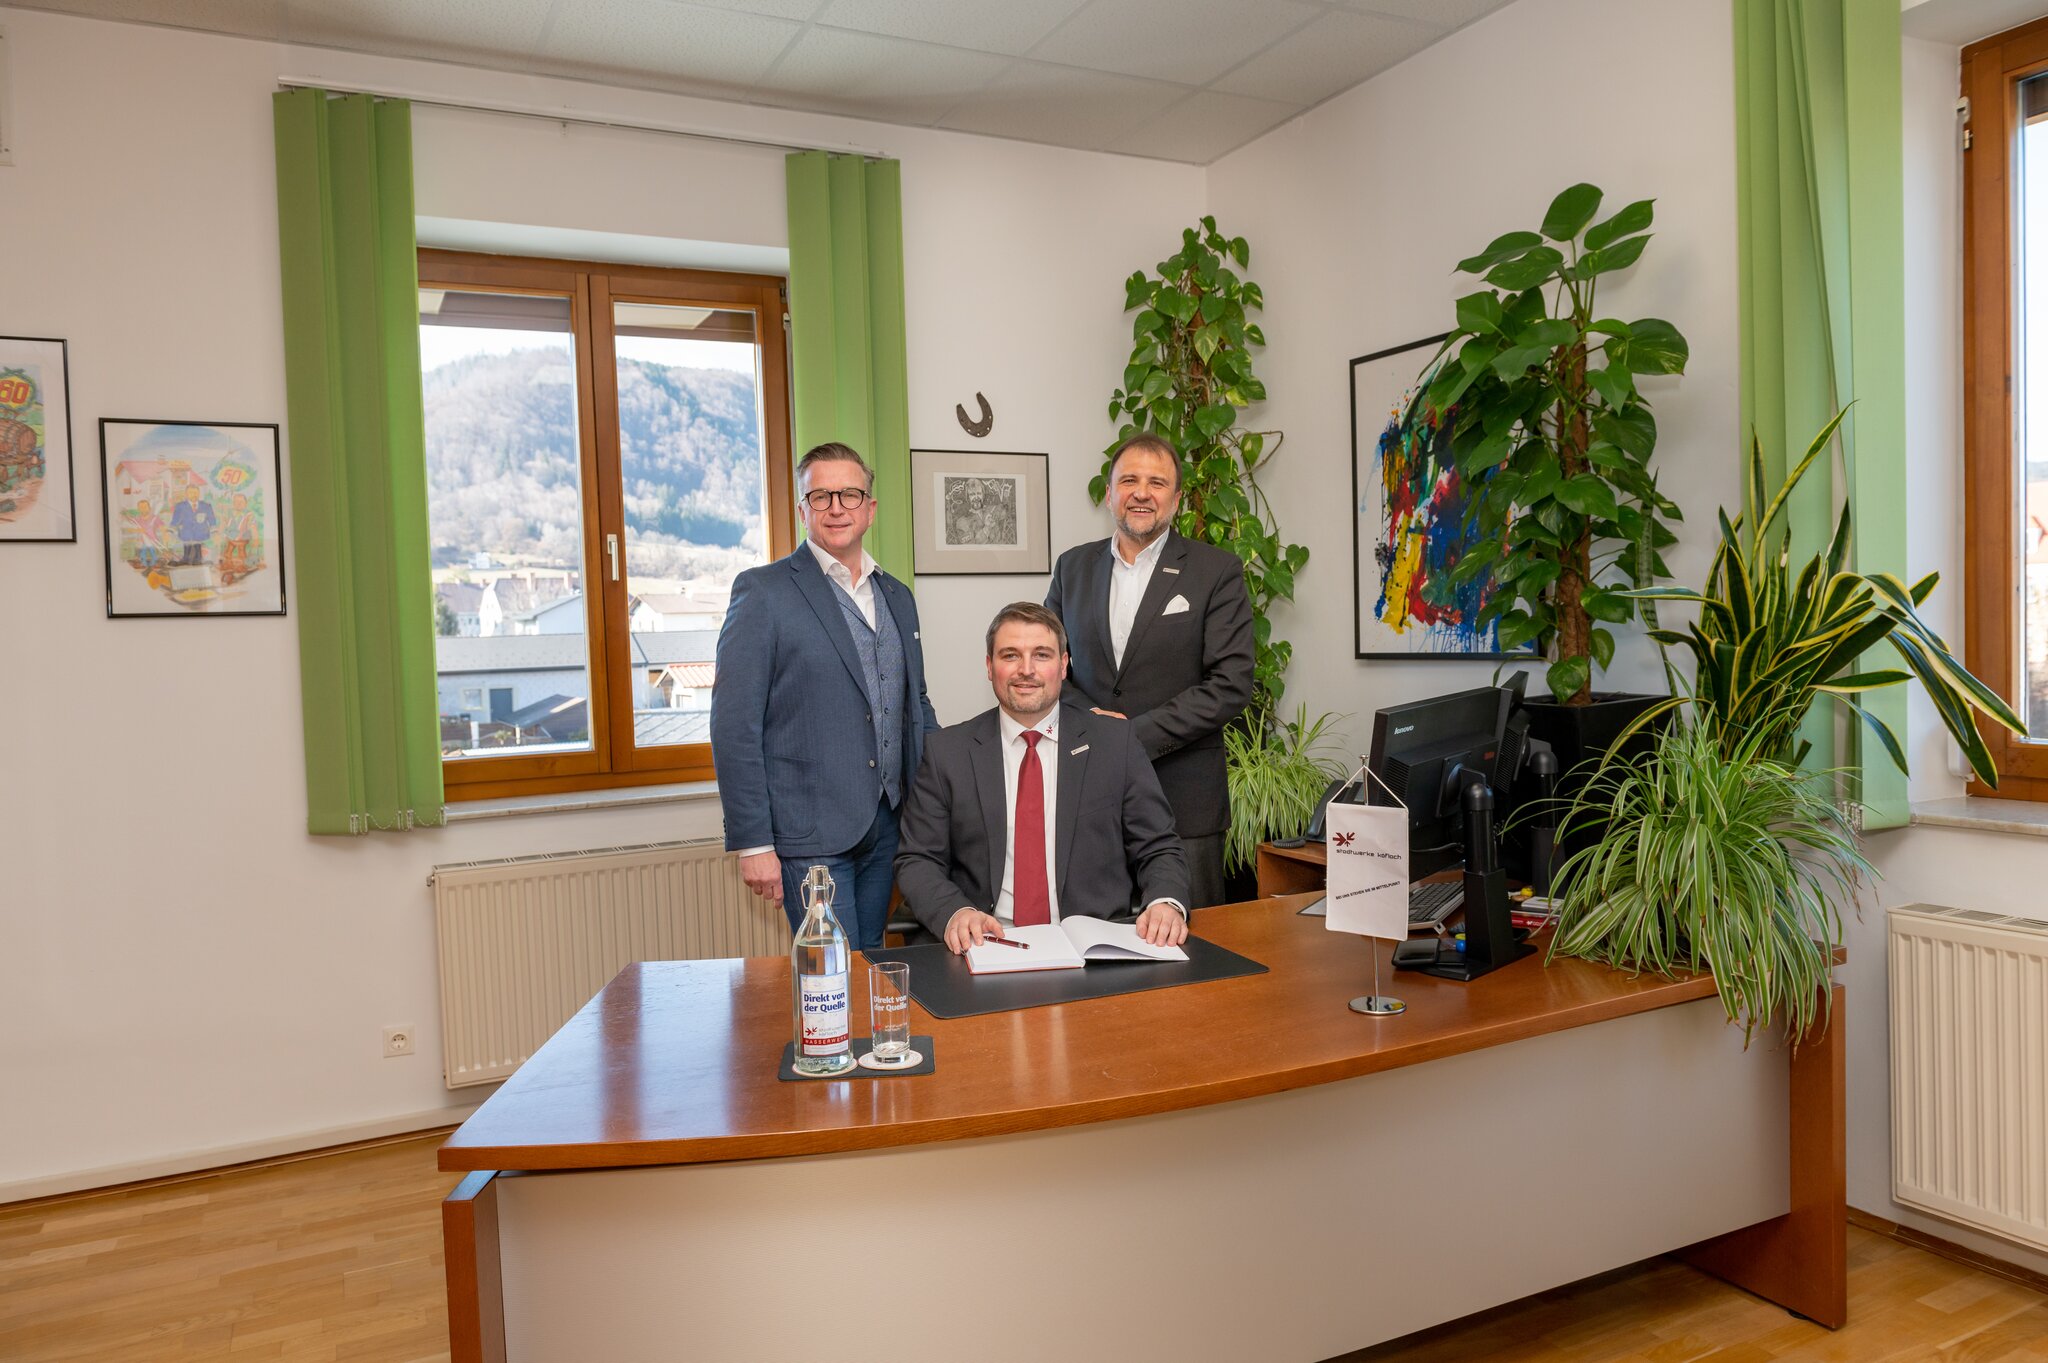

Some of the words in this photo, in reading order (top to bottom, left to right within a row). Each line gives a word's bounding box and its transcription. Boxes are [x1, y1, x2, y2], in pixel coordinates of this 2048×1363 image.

[1394, 725, 1414, 734] lenovo
[804, 994, 830, 1003] Direkt
[831, 992, 845, 1001] von
[873, 995, 894, 1004] Direkt
[804, 1003, 819, 1012] der
[820, 1000, 846, 1013] Quelle
